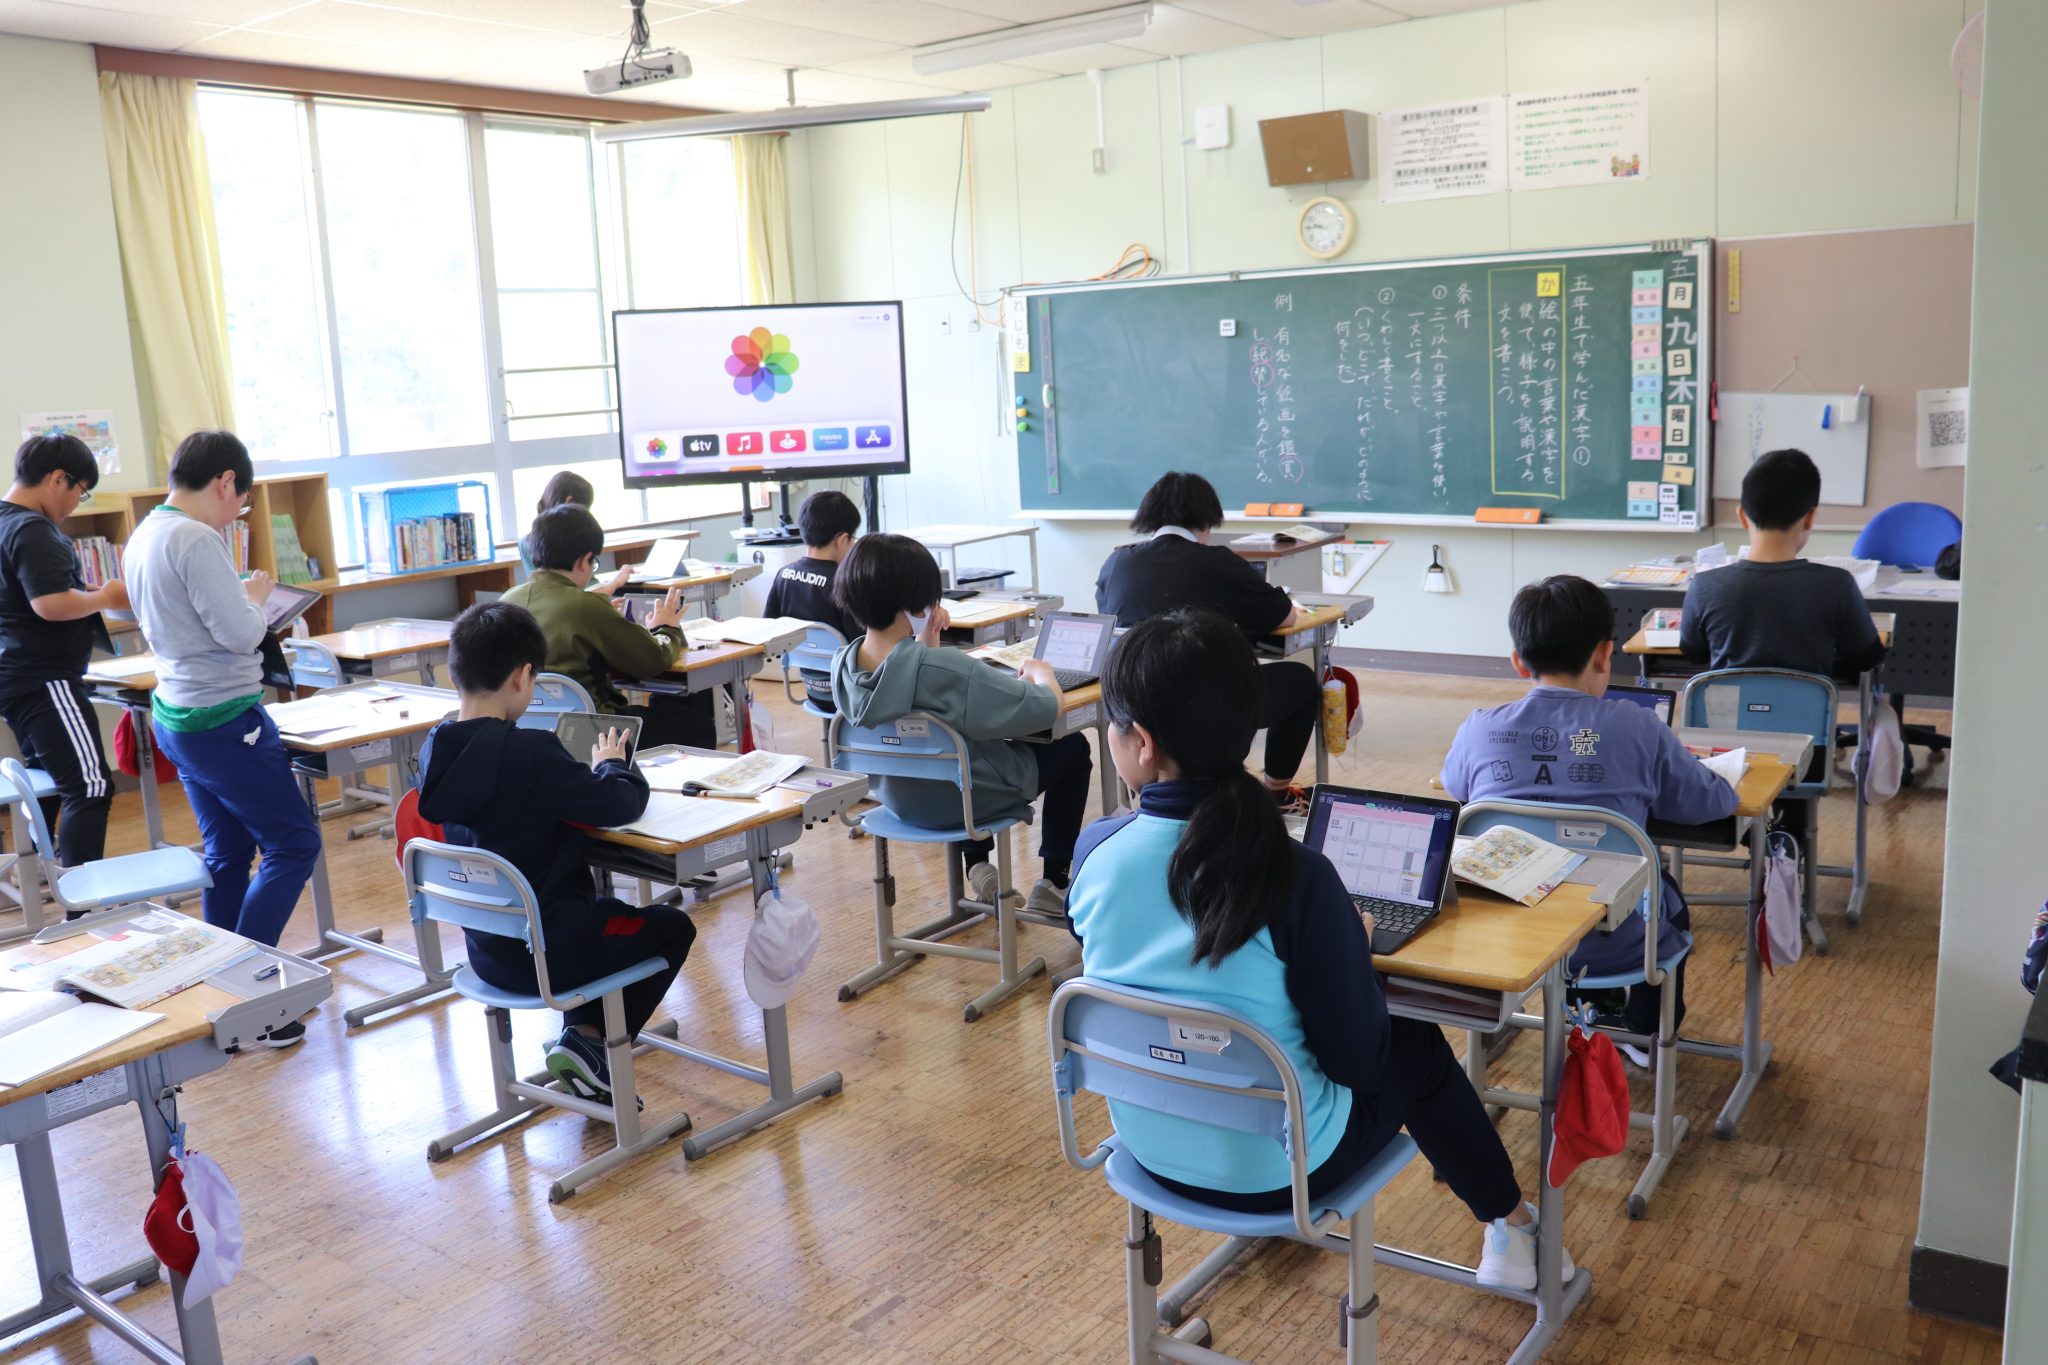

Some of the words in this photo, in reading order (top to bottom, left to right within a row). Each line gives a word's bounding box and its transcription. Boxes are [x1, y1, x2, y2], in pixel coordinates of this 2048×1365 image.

[1541, 277, 1556, 292] か
[1274, 293, 1293, 312] 例
[1454, 282, 1473, 329] 条件
[1405, 311, 1427, 411] 一文にすること。
[1494, 302, 1515, 405] 文を書こう。
[1513, 301, 1538, 482] 使って、様子を説明する
[1537, 300, 1560, 484] 絵の中の言葉や漢字を
[700, 439, 712, 451] tv
[781, 568, 827, 587] GIRAUDM
[1534, 763, 1553, 785] A
[1564, 828, 1571, 837] L
[1179, 1028, 1188, 1039] L
